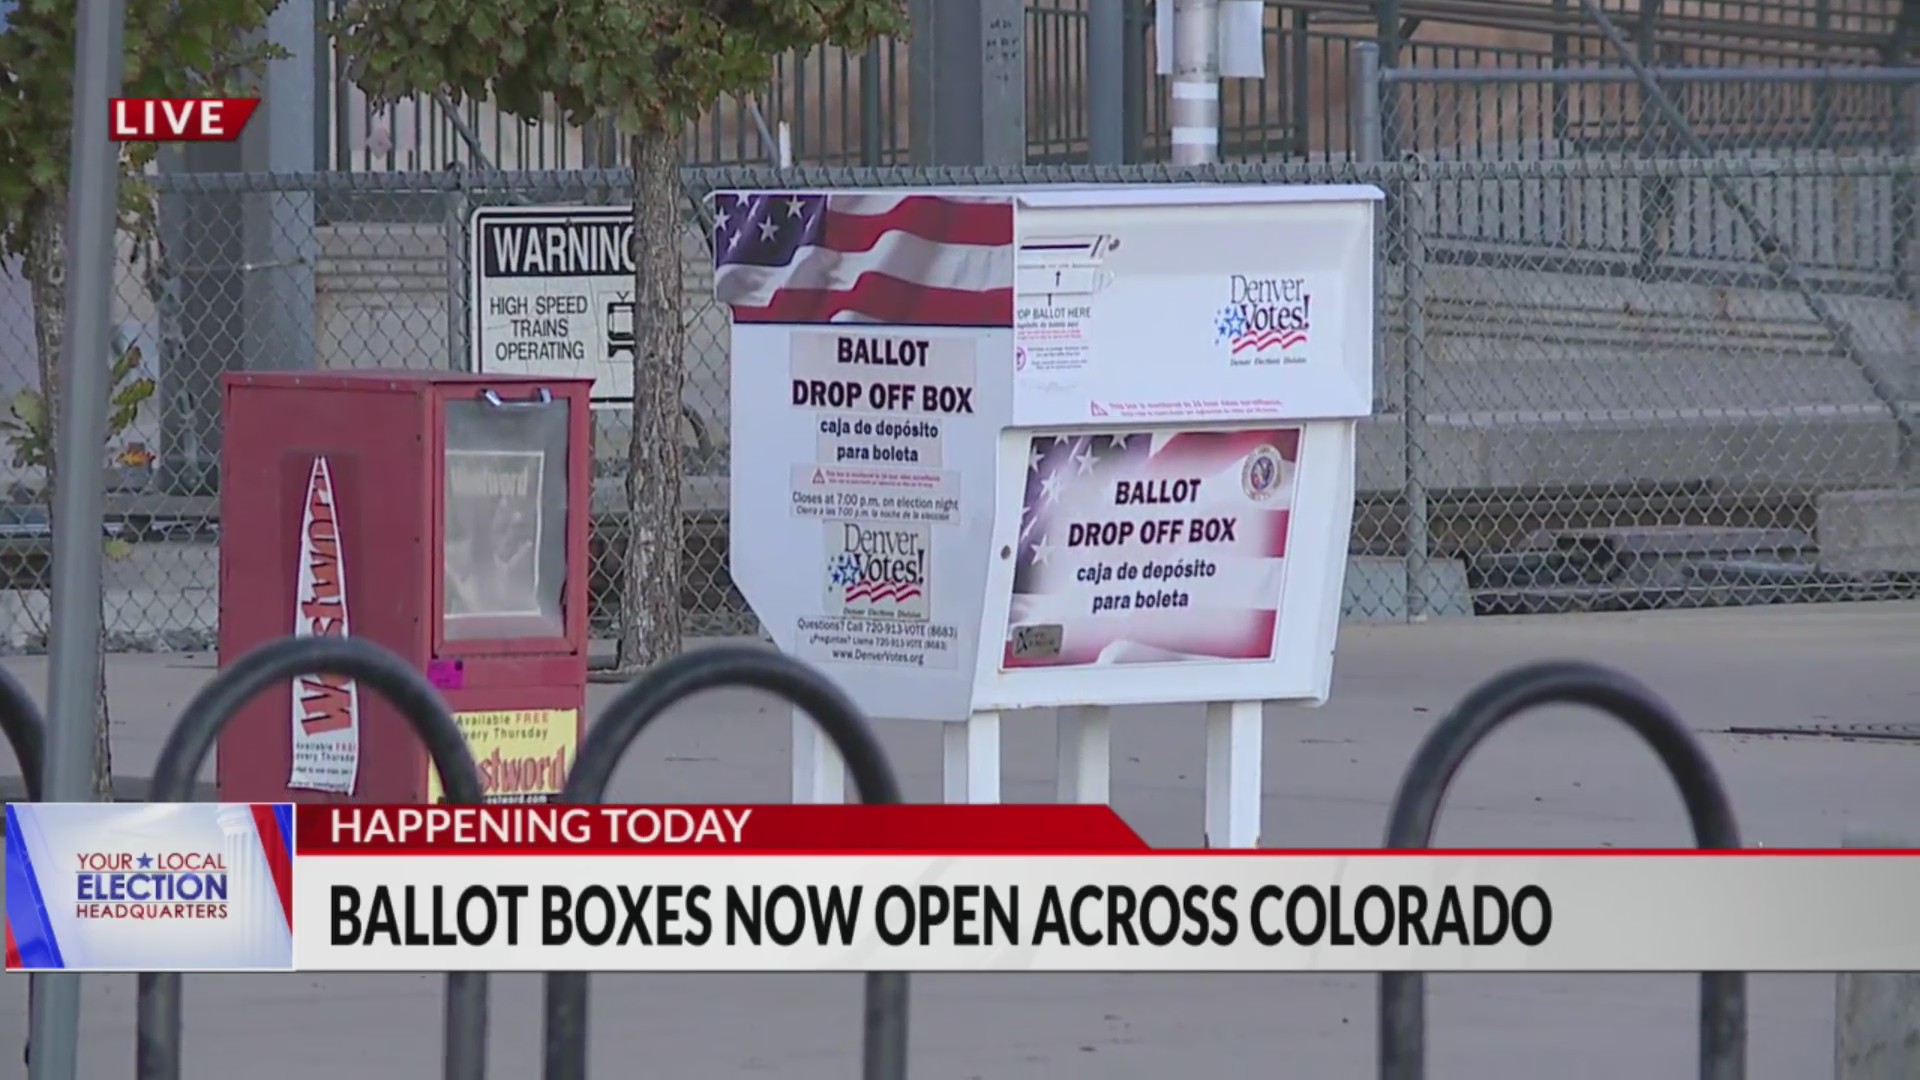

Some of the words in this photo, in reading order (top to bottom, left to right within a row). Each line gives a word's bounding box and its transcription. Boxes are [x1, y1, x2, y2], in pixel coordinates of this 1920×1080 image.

[1230, 274, 1305, 304] Denver
[489, 296, 528, 315] HIGH
[535, 295, 588, 315] SPEED
[1032, 307, 1065, 320] BALLOT
[1067, 306, 1091, 319] HERE
[1240, 294, 1310, 331] Votes!
[510, 318, 569, 337] TRAINS
[495, 341, 585, 361] OPERATING
[837, 336, 929, 367] BALLOT
[792, 379, 862, 408] DROP
[869, 382, 916, 410] OFF
[922, 385, 974, 414] BOX
[820, 417, 850, 437] caja
[854, 418, 872, 436] de
[875, 419, 938, 440] depósito
[836, 445, 869, 462] para
[873, 444, 919, 462] boleta
[792, 491, 822, 505] Closes
[825, 494, 834, 505] at
[883, 497, 894, 507] on
[897, 495, 934, 509] election
[935, 497, 959, 512] night
[1115, 478, 1202, 505] BALLOT
[844, 523, 919, 556] Denver
[1067, 521, 1134, 547] DROP
[1139, 519, 1184, 544] OFF
[1188, 517, 1237, 542] BOX
[853, 549, 924, 585] Votes!
[1076, 562, 1112, 585] caja
[1116, 561, 1138, 580] de
[1142, 557, 1216, 582] depósito
[1092, 591, 1130, 614] para
[1134, 588, 1189, 609] boleta
[797, 617, 845, 631] Questions?
[847, 620, 863, 632] Call
[456, 714, 511, 726] Available
[515, 712, 550, 725] FREE
[463, 730, 489, 743] very
[493, 727, 549, 740] Thursday
[478, 744, 566, 793] stword
